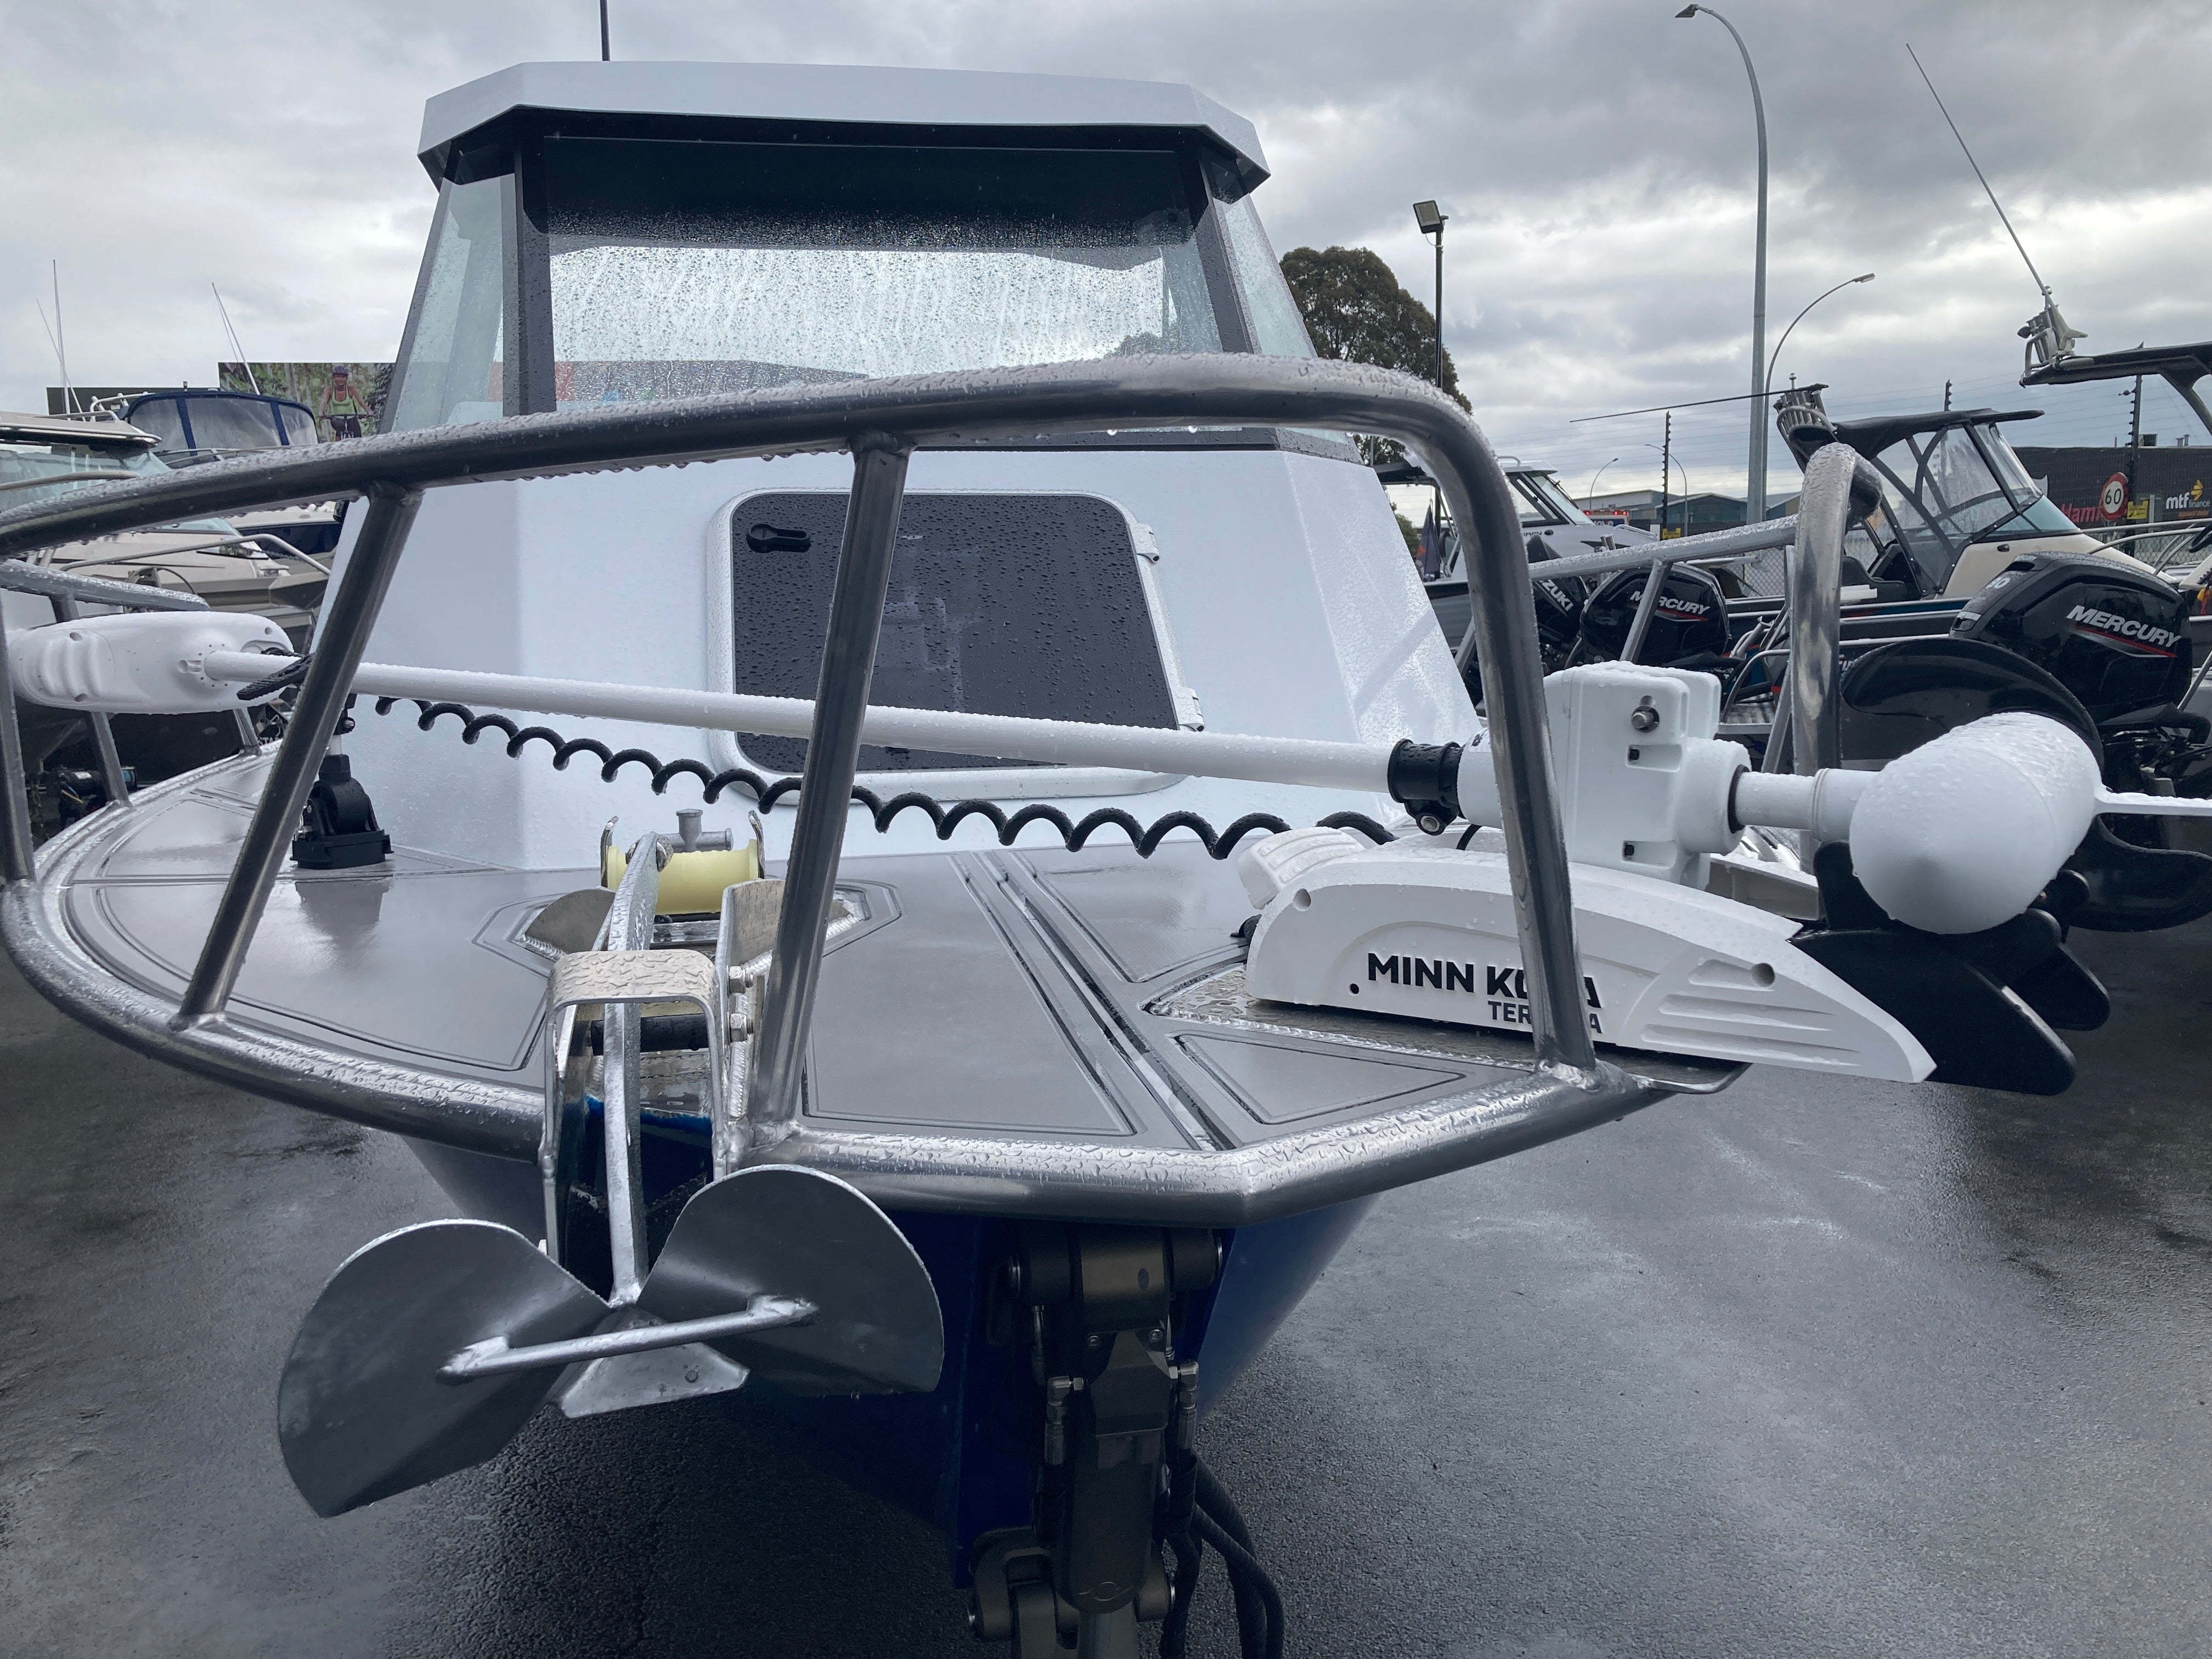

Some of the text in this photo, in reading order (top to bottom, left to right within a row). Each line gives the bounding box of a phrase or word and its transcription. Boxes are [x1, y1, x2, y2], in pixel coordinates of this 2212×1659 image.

[2105, 488, 2121, 505] 60
[2166, 492, 2211, 509] mtf finance
[1539, 579, 1573, 611] ZUKI
[1630, 590, 1710, 615] MRCURY
[2066, 605, 2182, 647] MERCURY
[1368, 953, 1601, 1008] MINN KA
[1487, 1000, 1602, 1034] TERA
